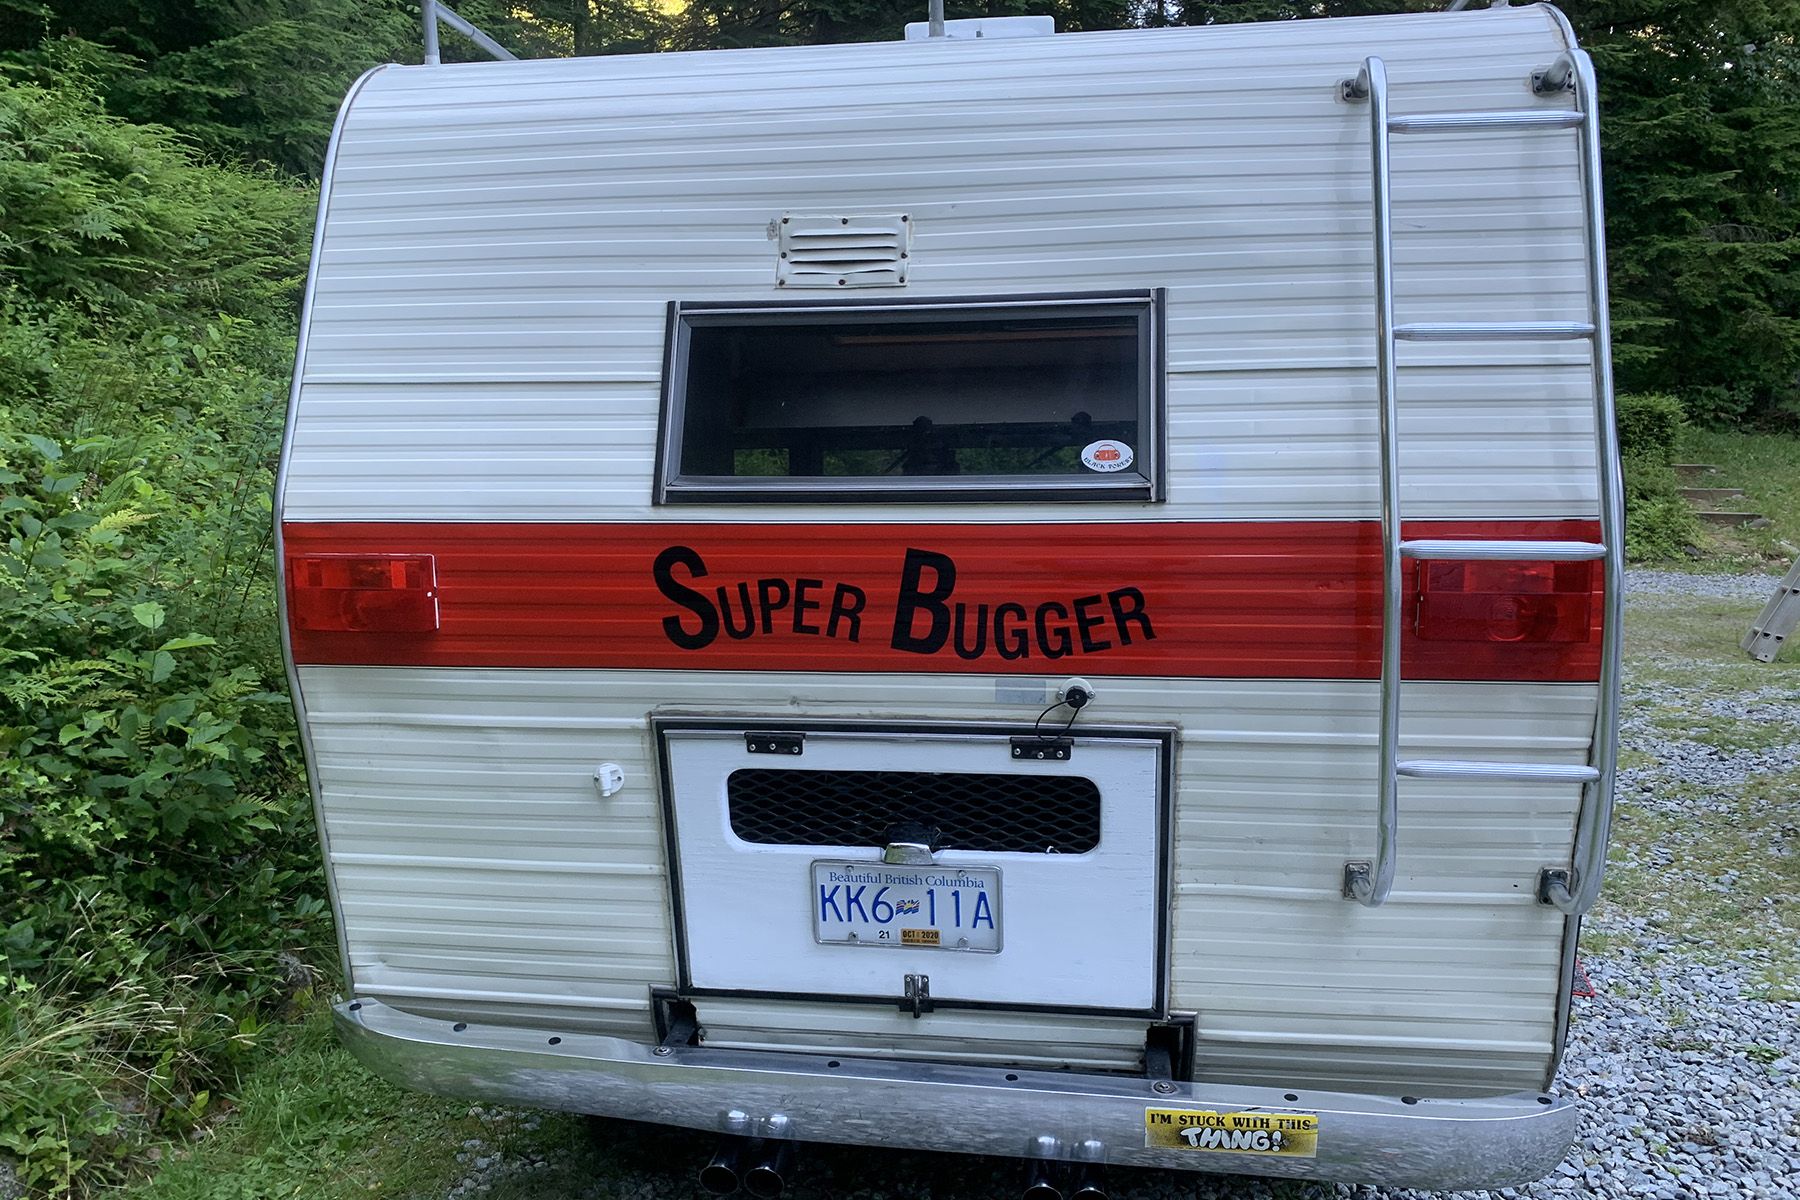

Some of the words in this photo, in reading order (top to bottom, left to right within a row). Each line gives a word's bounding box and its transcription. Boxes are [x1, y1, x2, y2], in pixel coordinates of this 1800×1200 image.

[829, 871, 882, 884] Beautiful
[885, 874, 922, 886] British
[925, 876, 985, 888] Columbia
[820, 884, 894, 923] KK6
[927, 889, 994, 929] 11A
[878, 930, 890, 939] 21
[902, 930, 915, 938] OCT
[921, 931, 939, 940] 2020
[1150, 1113, 1172, 1125] I'M
[1178, 1115, 1226, 1127] STUCK
[1232, 1117, 1270, 1129] WITH
[1278, 1118, 1311, 1130] THIS
[1180, 1127, 1282, 1152] THING!
